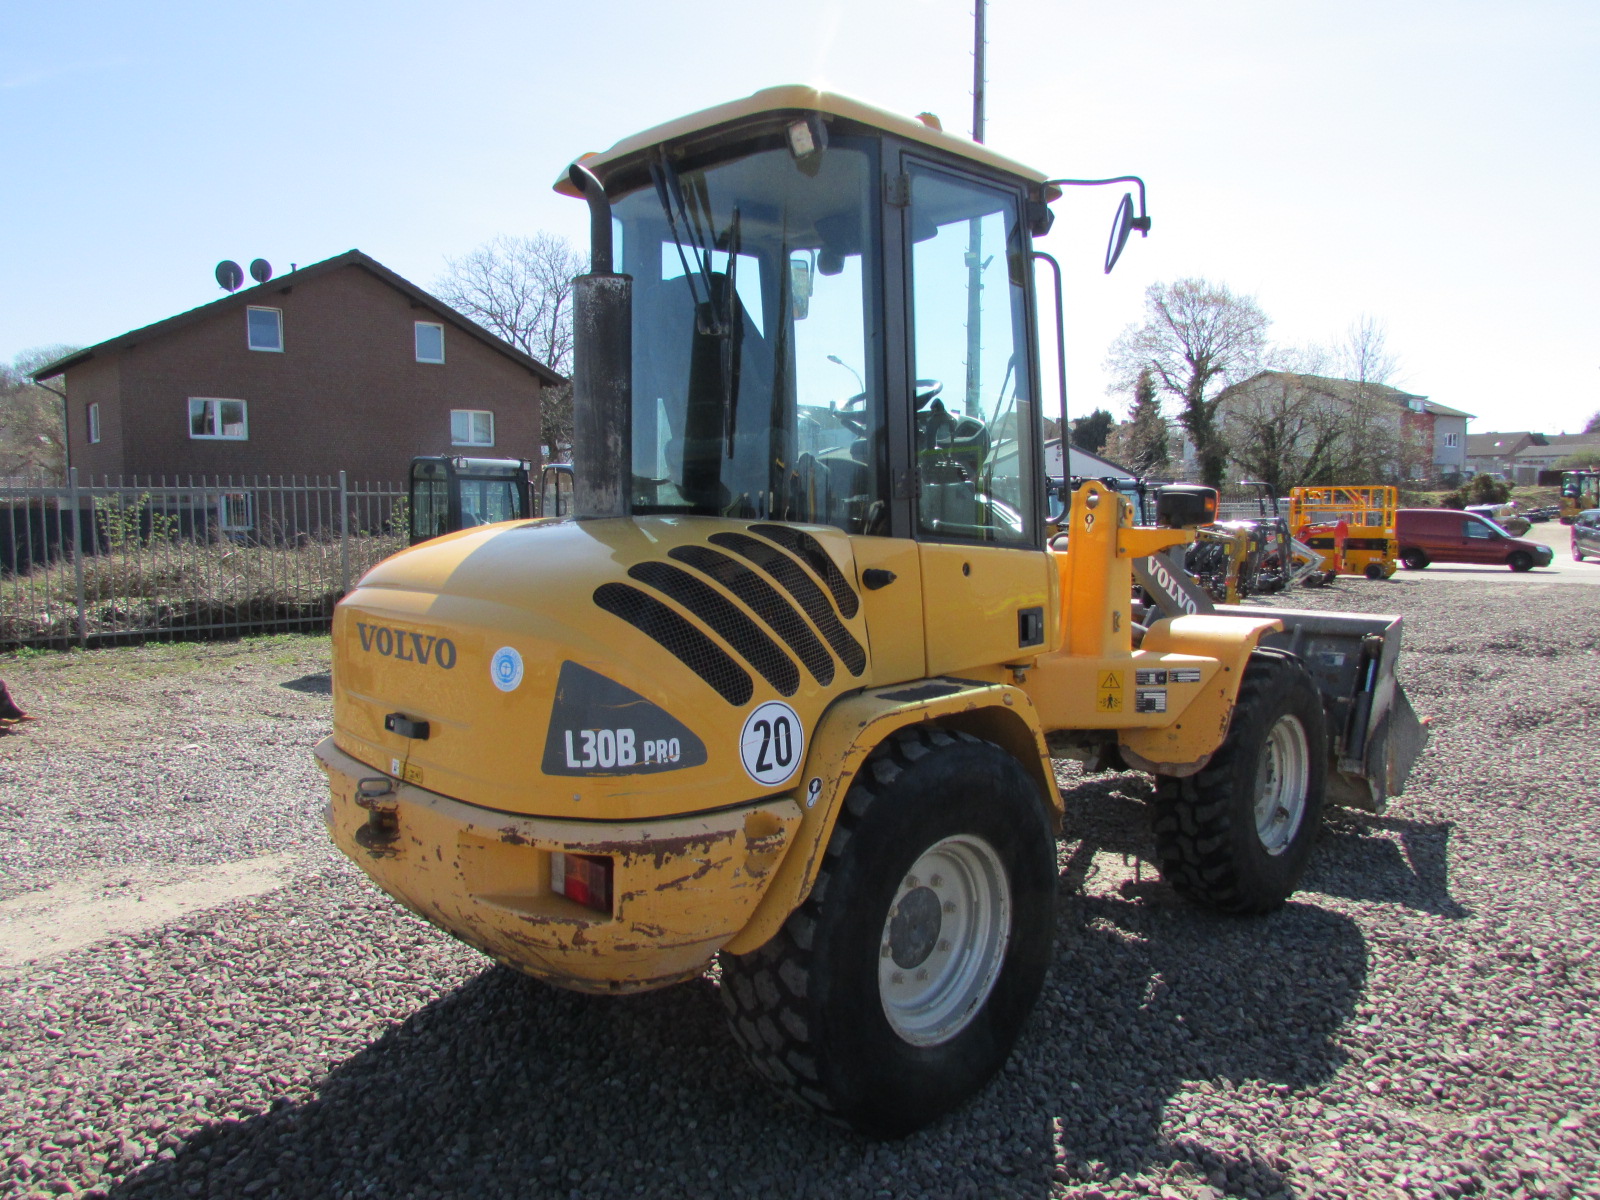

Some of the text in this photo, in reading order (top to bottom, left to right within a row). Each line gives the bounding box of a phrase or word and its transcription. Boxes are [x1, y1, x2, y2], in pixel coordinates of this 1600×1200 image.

[1147, 555, 1197, 615] VOLVO
[356, 622, 457, 669] VOLVO
[565, 728, 681, 768] L30B PRO
[753, 715, 793, 773] 20
